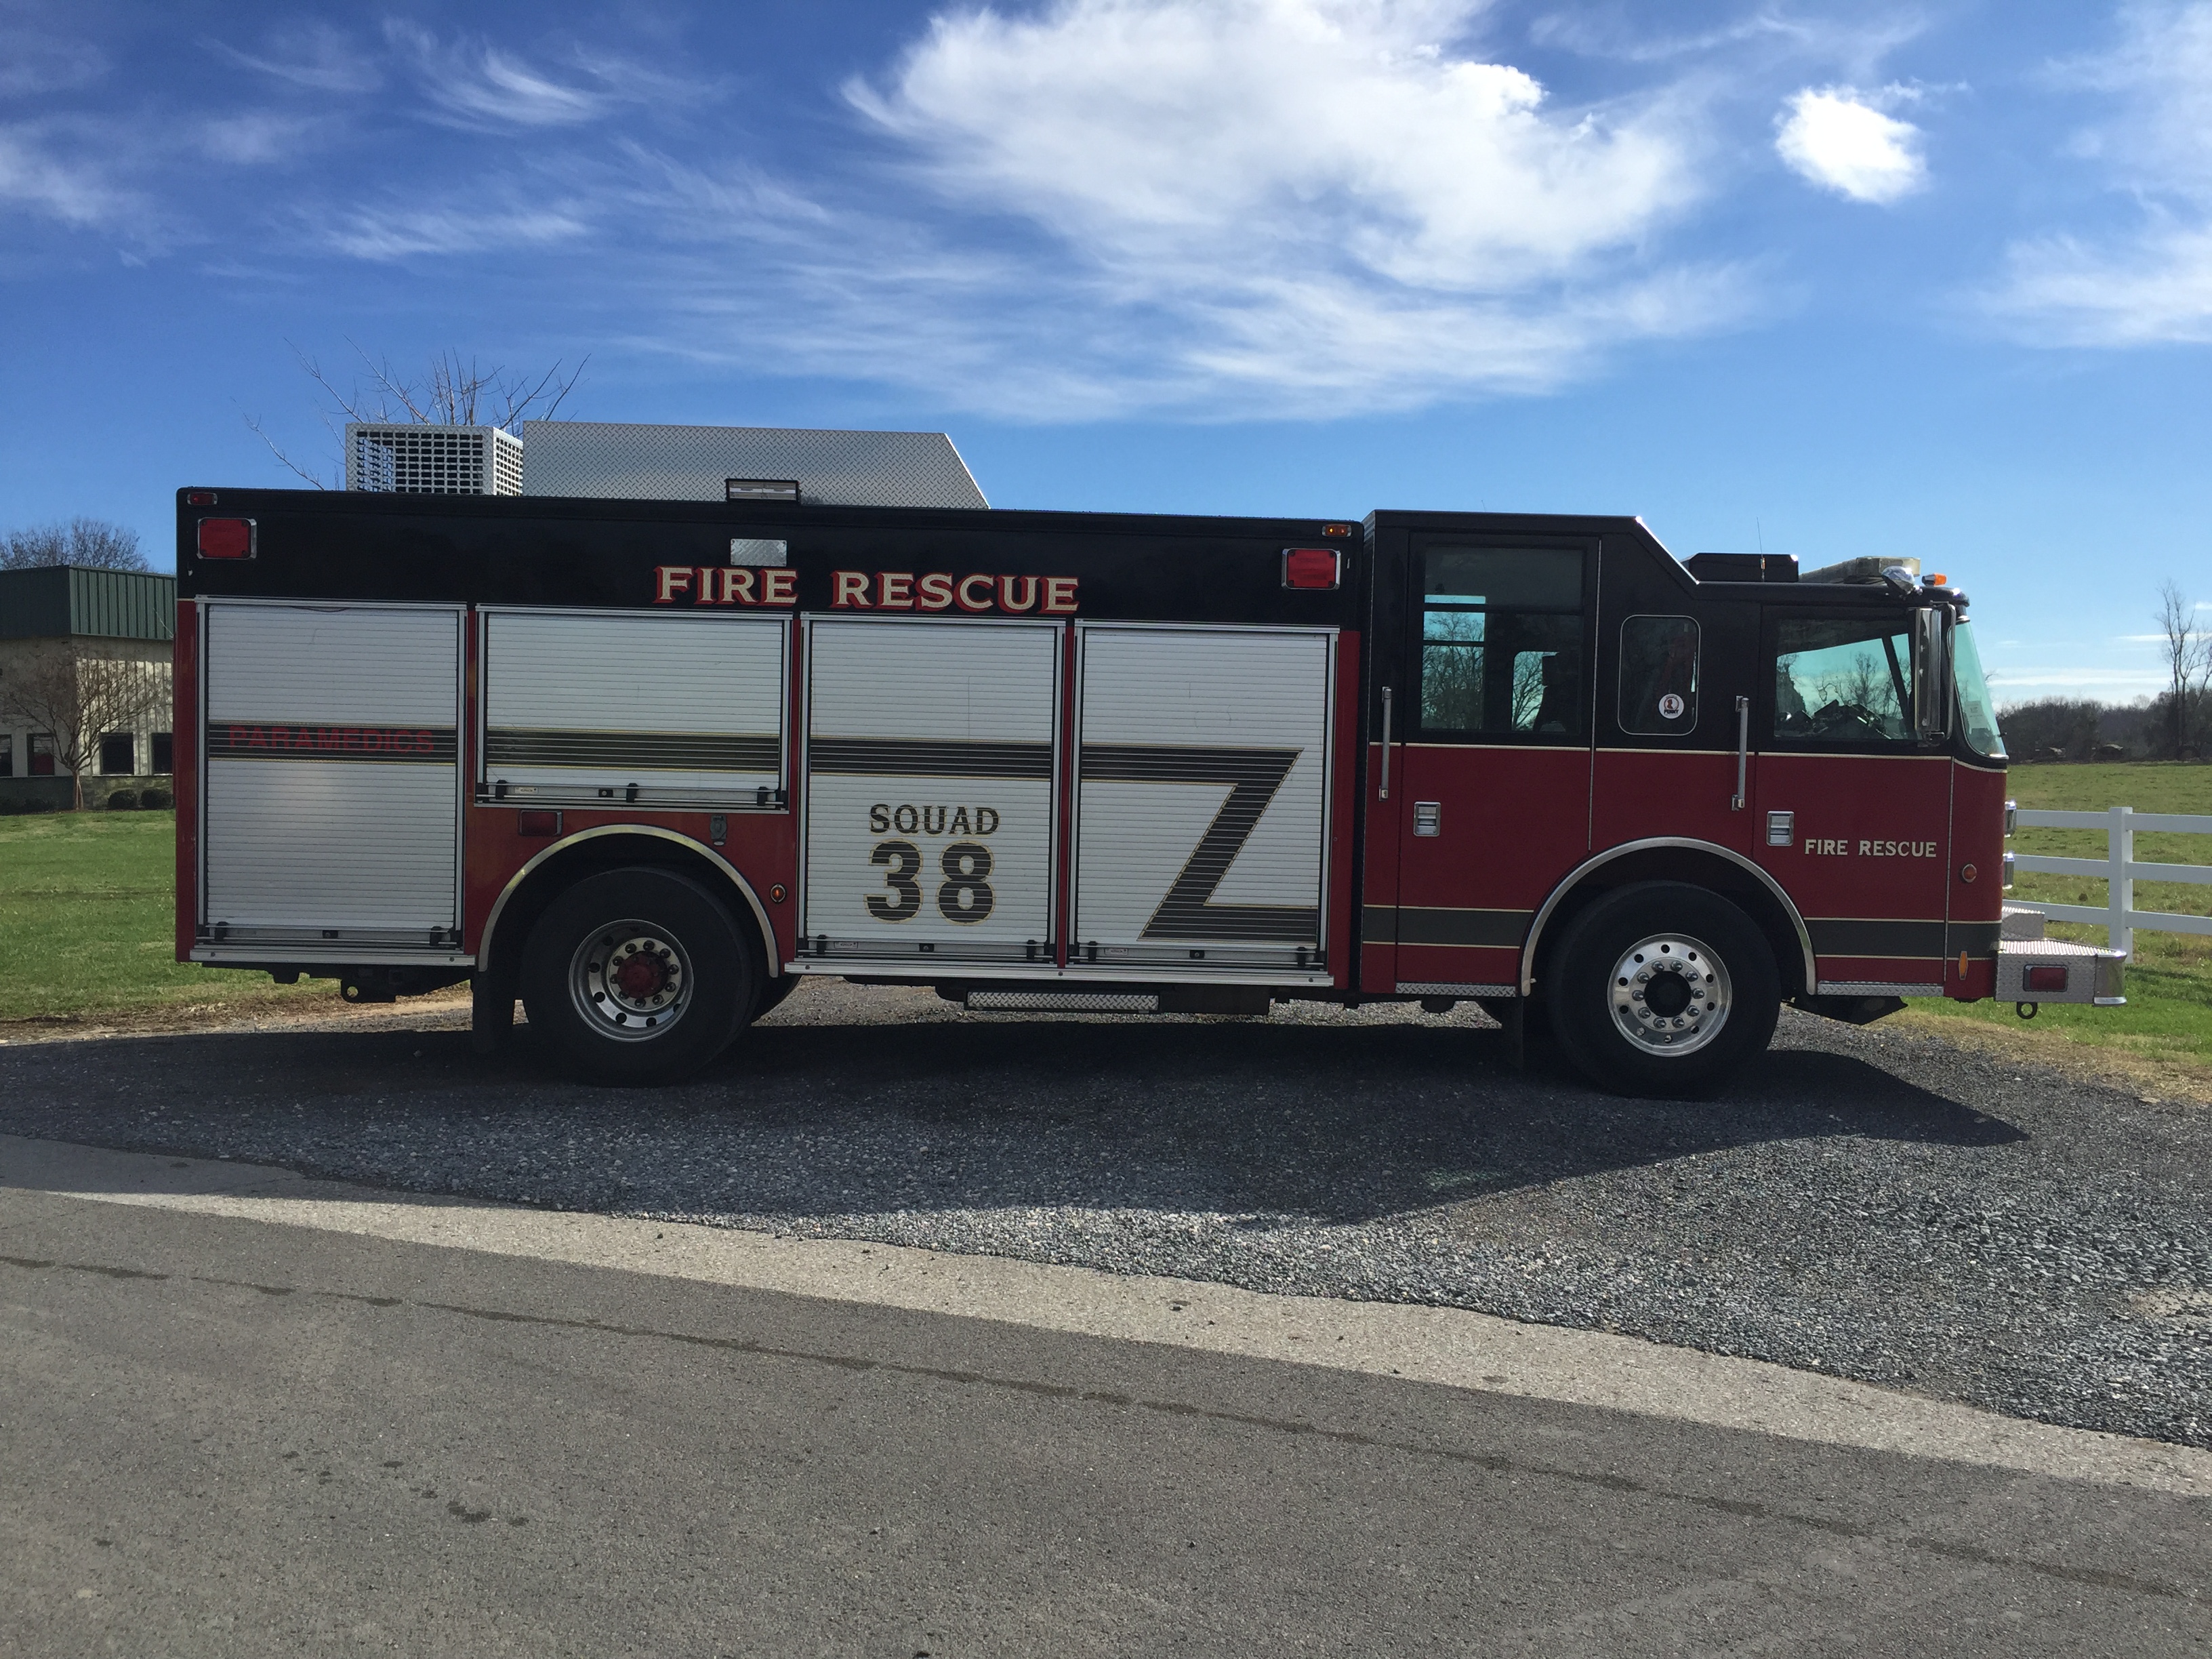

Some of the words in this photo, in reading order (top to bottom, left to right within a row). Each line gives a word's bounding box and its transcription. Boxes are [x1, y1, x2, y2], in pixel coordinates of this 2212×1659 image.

[654, 566, 798, 605] FIRE
[830, 571, 1079, 613] RESCUE
[229, 726, 434, 753] PARAMEDICS
[870, 804, 1000, 836] SQUAD
[1805, 839, 1848, 855] FIRE
[1858, 840, 1937, 857] RESCUE
[864, 838, 996, 925] 38
